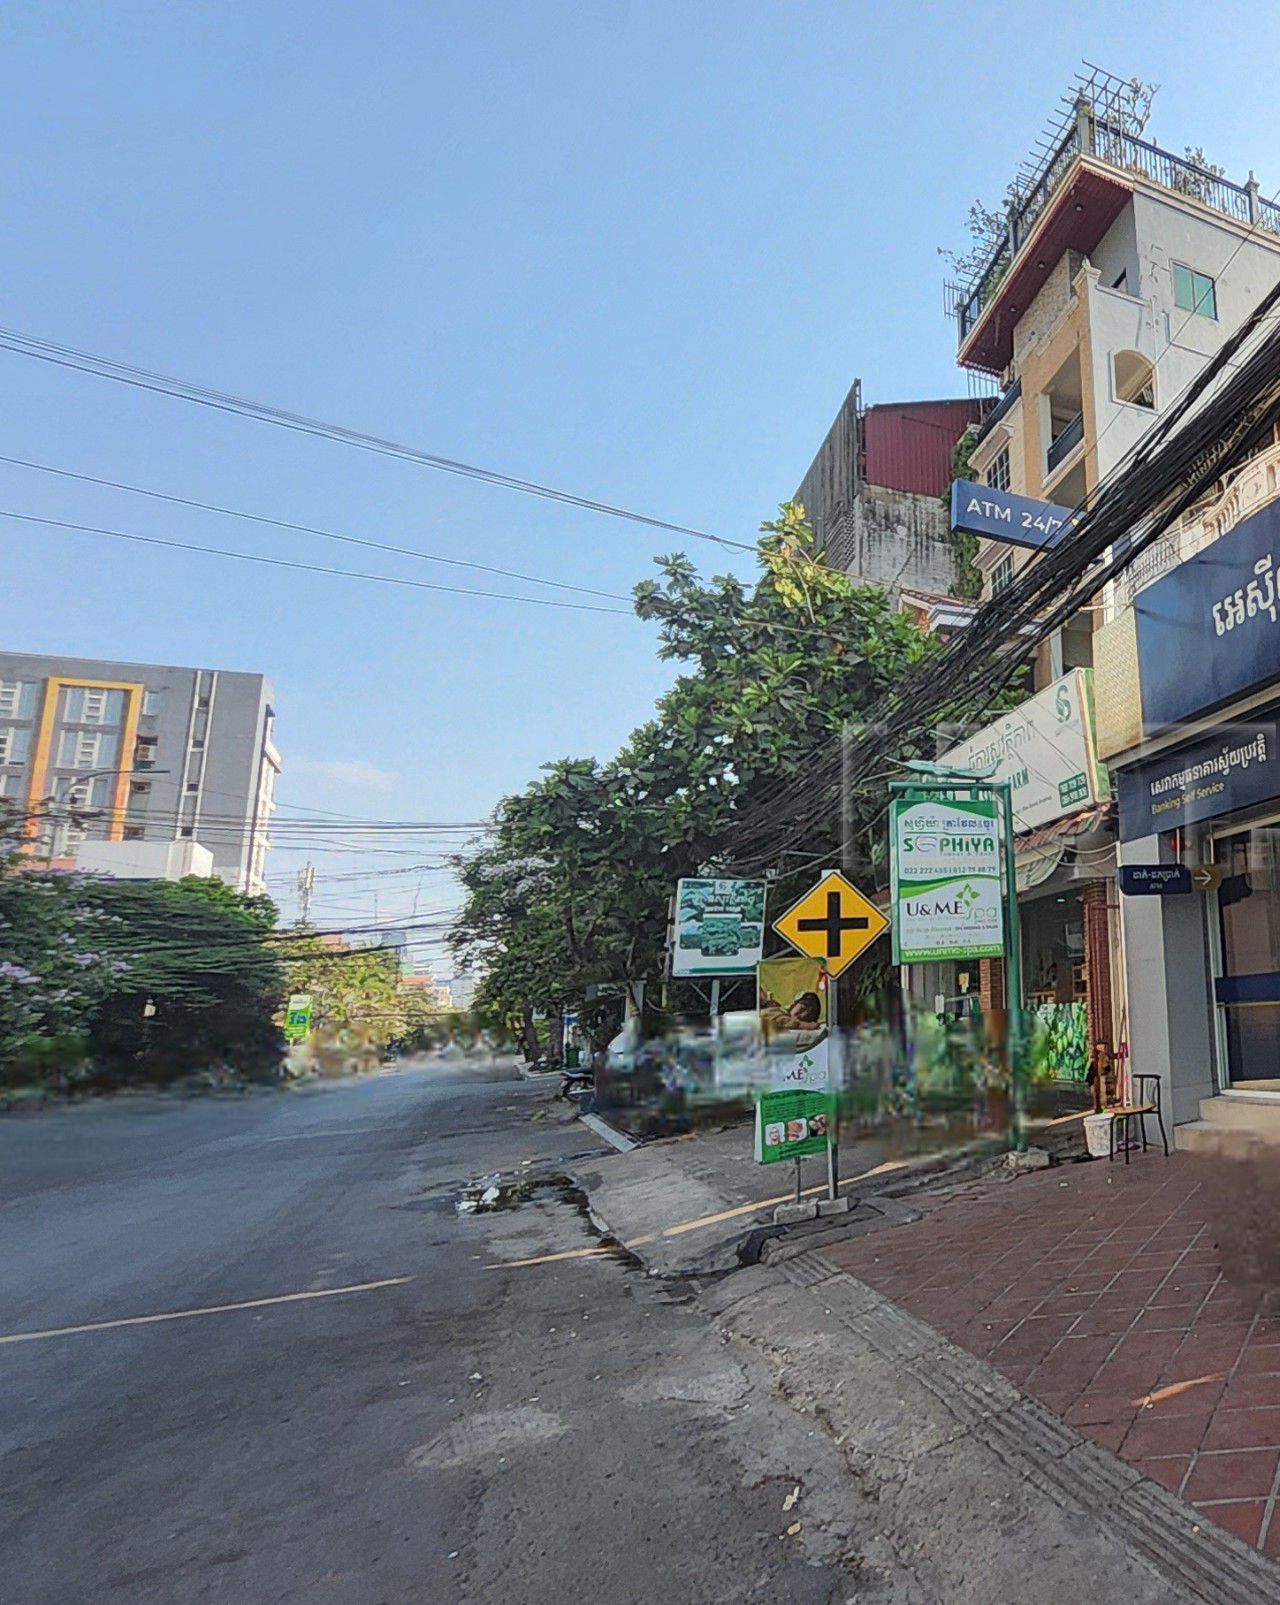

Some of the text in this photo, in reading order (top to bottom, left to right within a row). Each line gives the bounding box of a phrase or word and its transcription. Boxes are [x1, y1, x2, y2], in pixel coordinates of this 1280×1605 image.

[966, 497, 1064, 535] ATM 24/7
[1151, 781, 1225, 815] Banking Self Service
